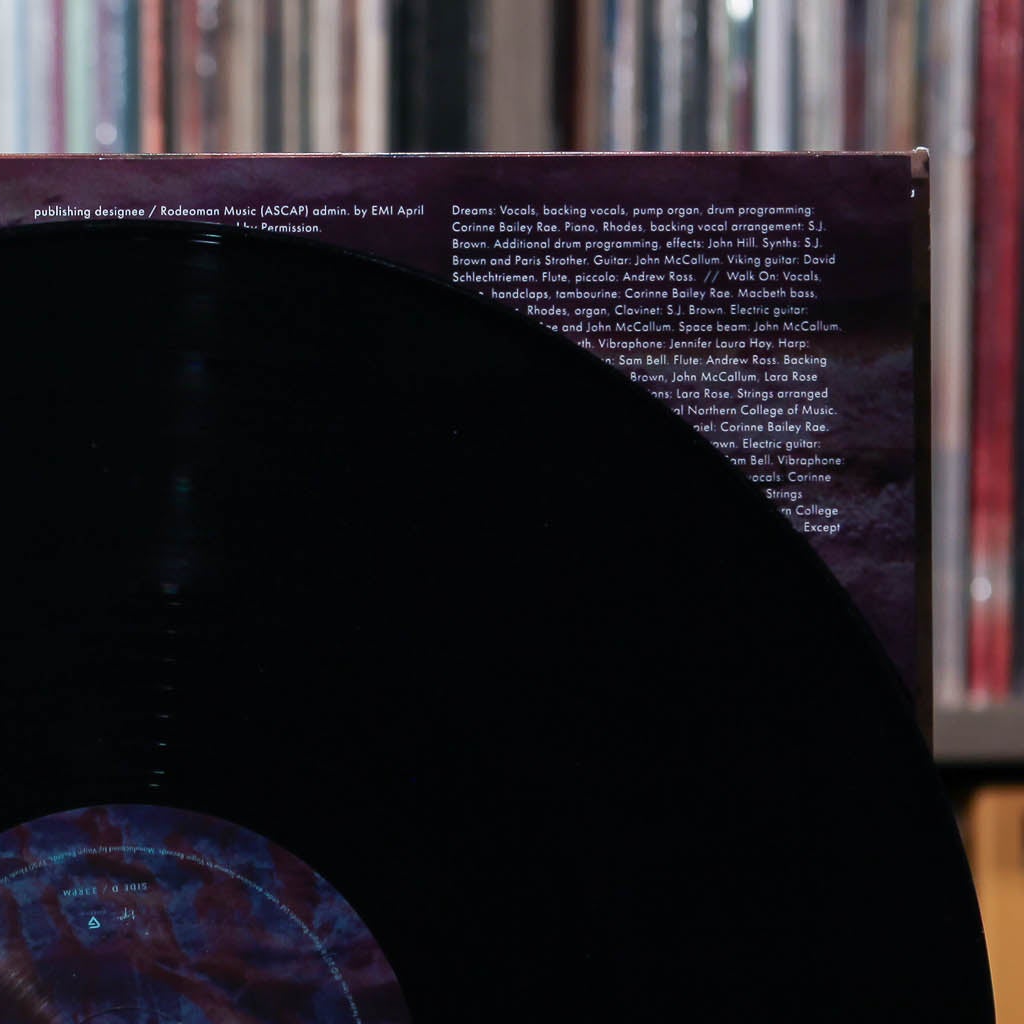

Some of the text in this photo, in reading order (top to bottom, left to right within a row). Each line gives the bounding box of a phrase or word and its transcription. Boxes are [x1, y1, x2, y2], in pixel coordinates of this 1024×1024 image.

[34, 205, 424, 219] publishing designee / Rodeoman Music (ASCAP) admin. by EMI April
[452, 204, 814, 218] Dreams: Vocals, backing vocals, pump organ, drum programming:
[262, 222, 321, 232] Permission.
[453, 270, 820, 284] Schlechtriemen. Flute, piccolo: Andrew Ross. // Walk On: Vocals,
[672, 371, 696, 382] John
[701, 371, 759, 382] McCallum,
[765, 372, 788, 382] Lara
[792, 371, 818, 381] Rose
[766, 488, 802, 501] Strings
[804, 522, 840, 534] Except
